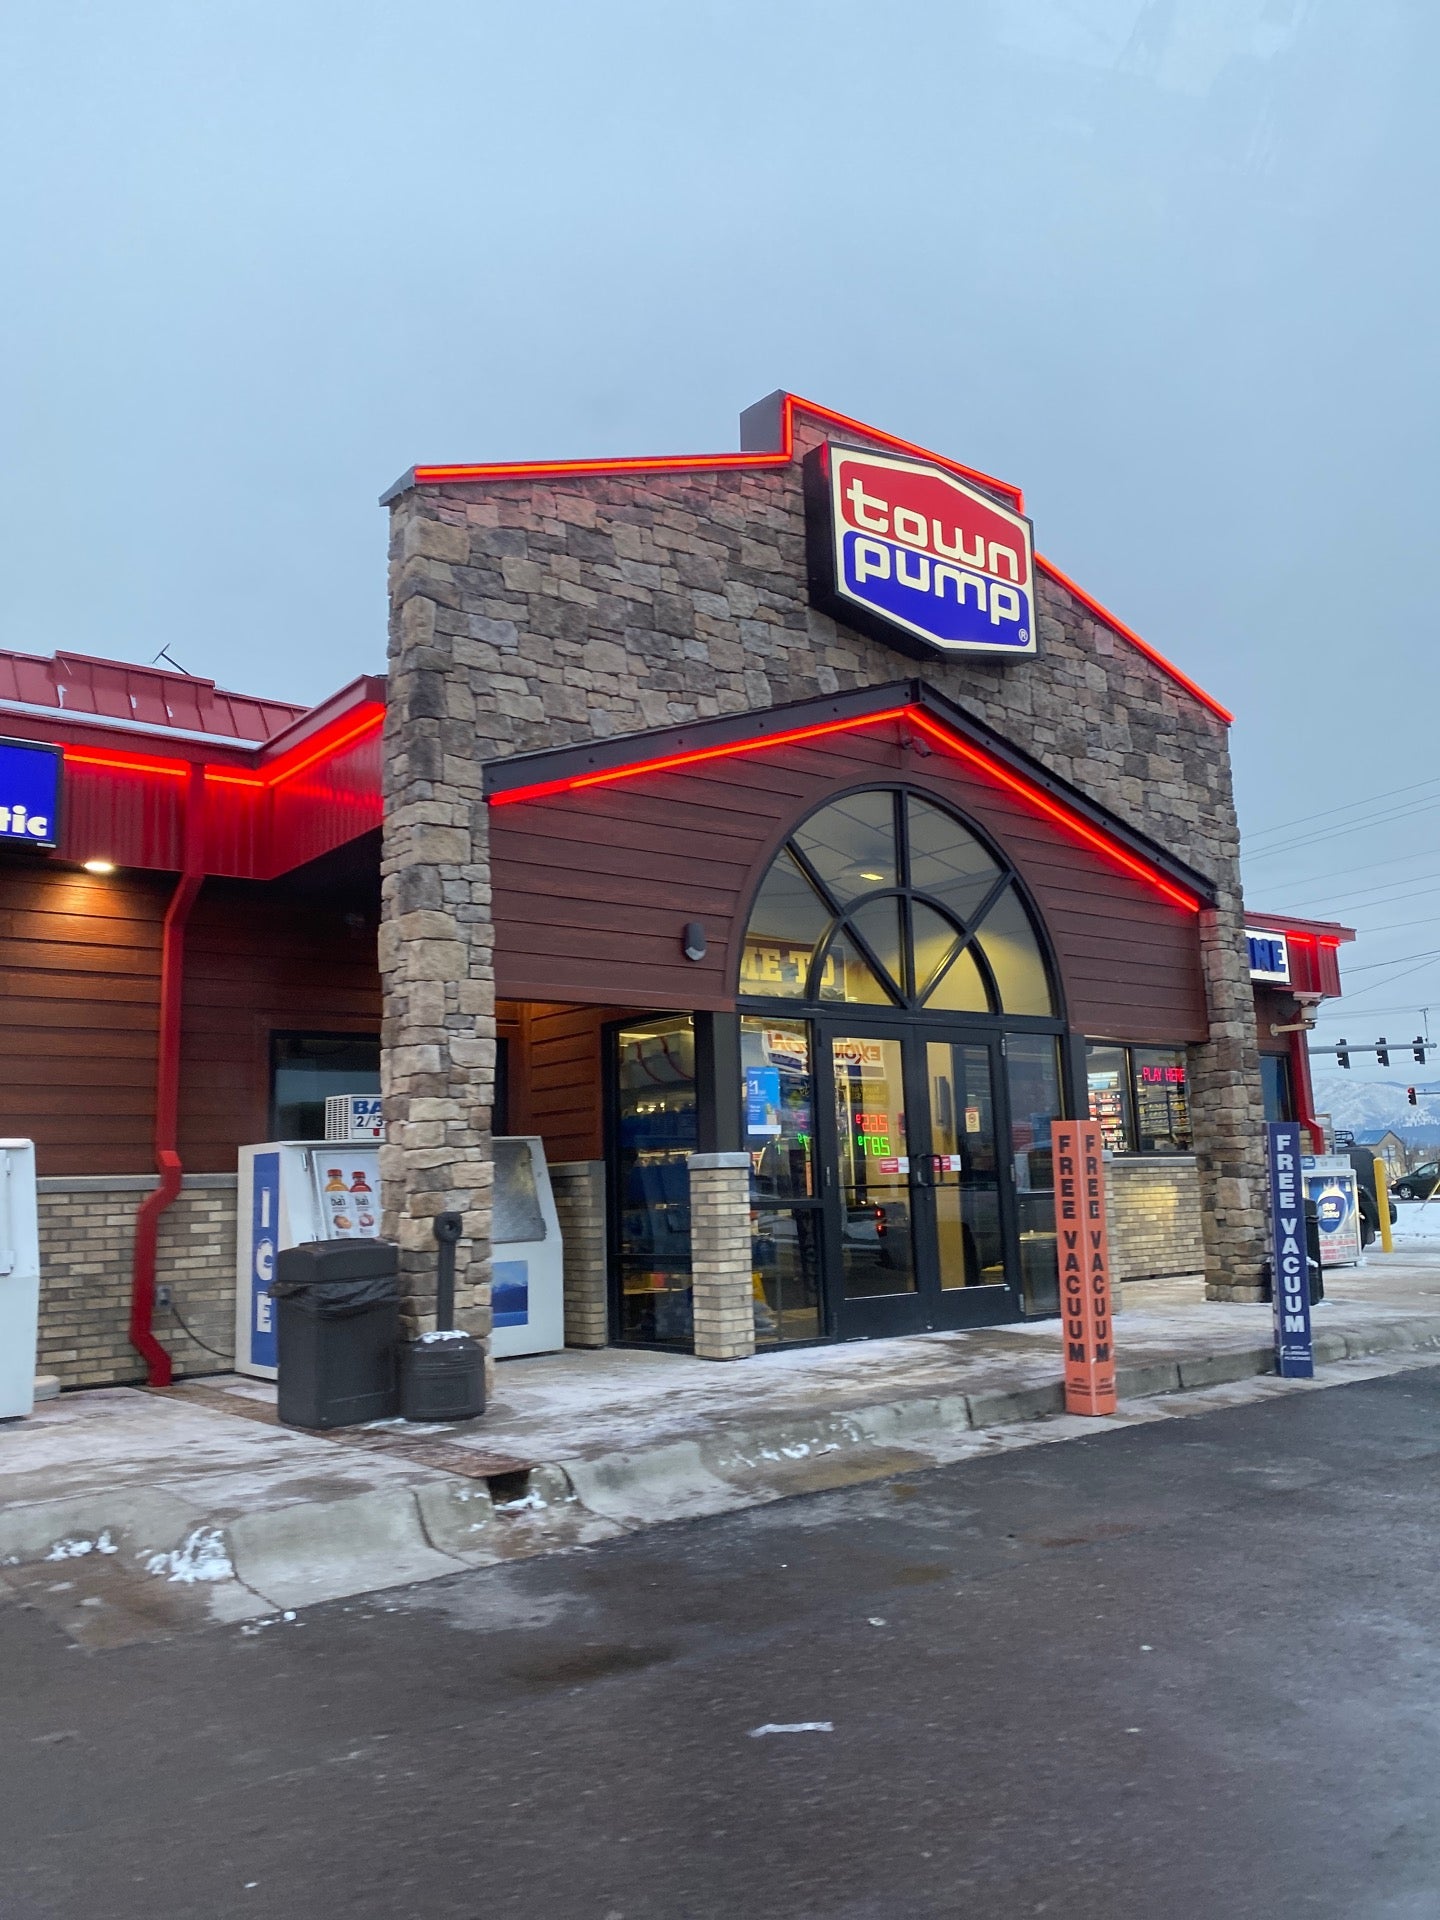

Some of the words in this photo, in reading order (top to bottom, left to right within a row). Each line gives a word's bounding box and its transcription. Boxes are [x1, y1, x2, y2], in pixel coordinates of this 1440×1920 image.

[846, 478, 1019, 582] town
[854, 537, 1021, 626] pump
[1142, 1067, 1162, 1082] PLAY
[1165, 1067, 1187, 1083] HERE
[1058, 1135, 1076, 1219] FREE
[1085, 1134, 1100, 1219] FREE
[1276, 1134, 1296, 1209] FREE
[256, 1187, 273, 1333] ICE
[1063, 1230, 1086, 1363] VACUUM
[1090, 1230, 1109, 1363] VACUUM
[1280, 1218, 1305, 1333] VACUUM
